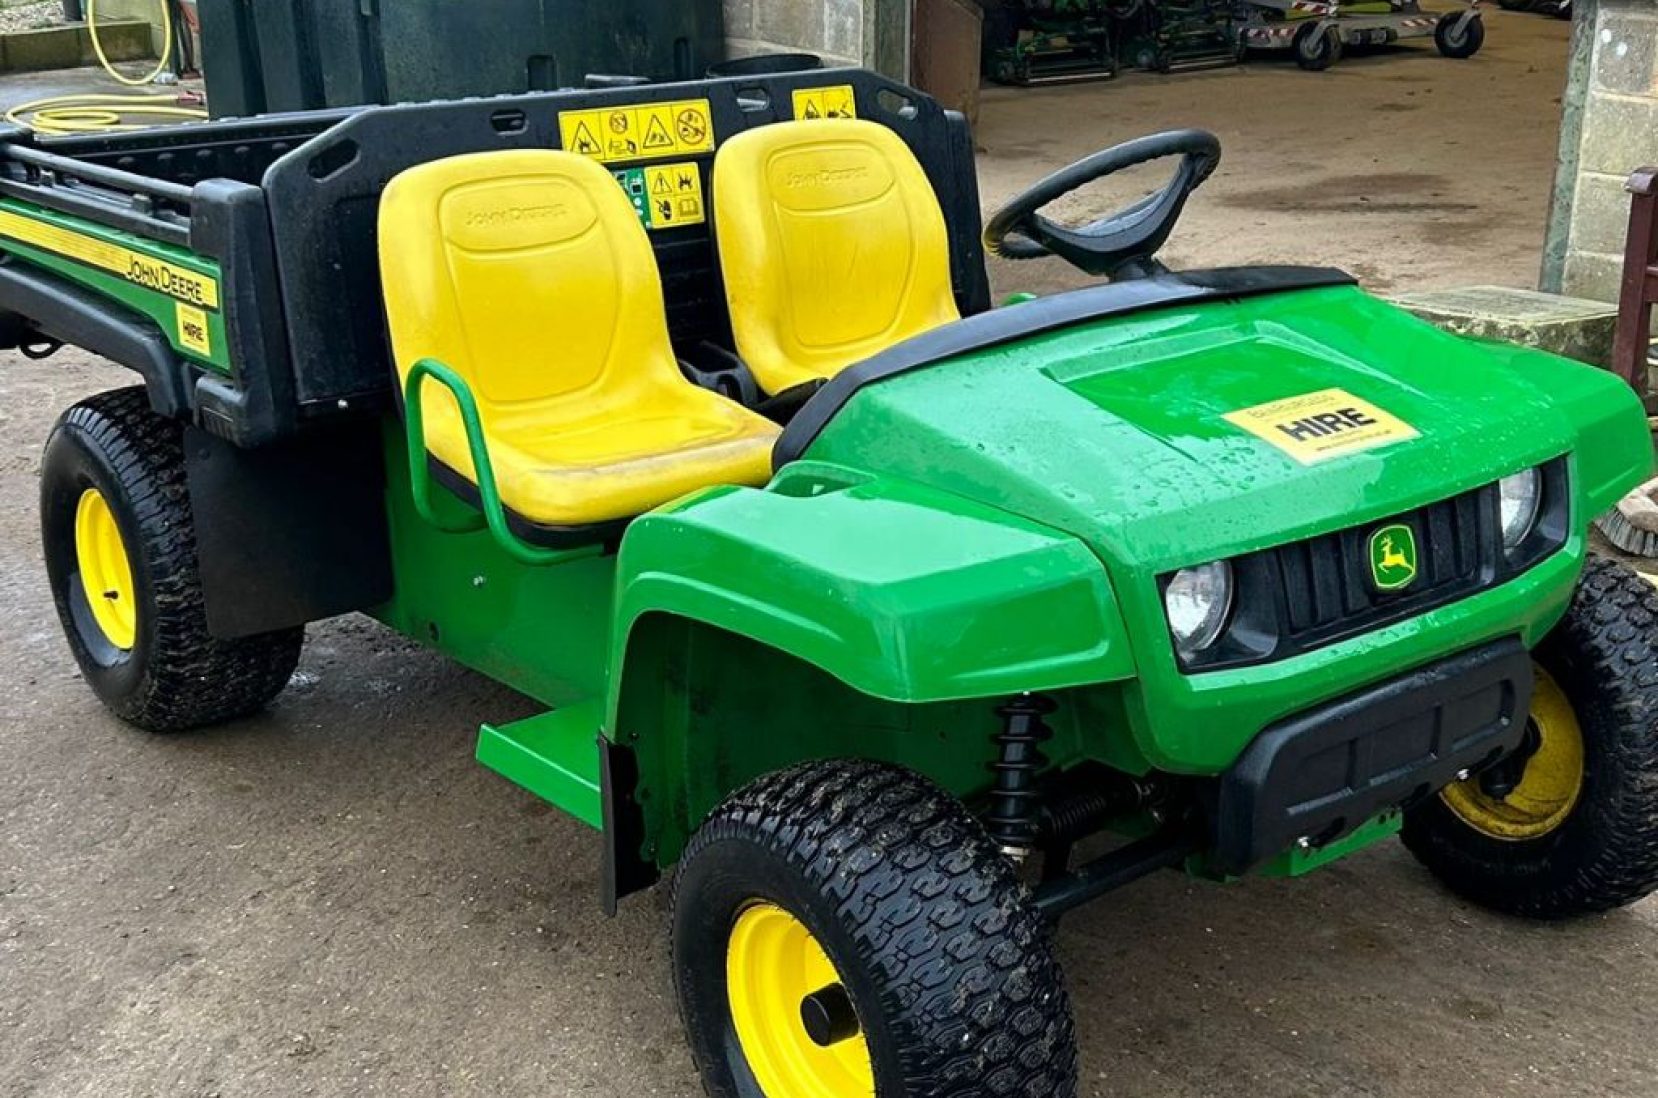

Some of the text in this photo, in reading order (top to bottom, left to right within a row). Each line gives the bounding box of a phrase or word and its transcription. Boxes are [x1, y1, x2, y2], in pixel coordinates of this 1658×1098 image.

[127, 255, 203, 302] JOHN DEERE
[1275, 407, 1378, 442] HIRE
